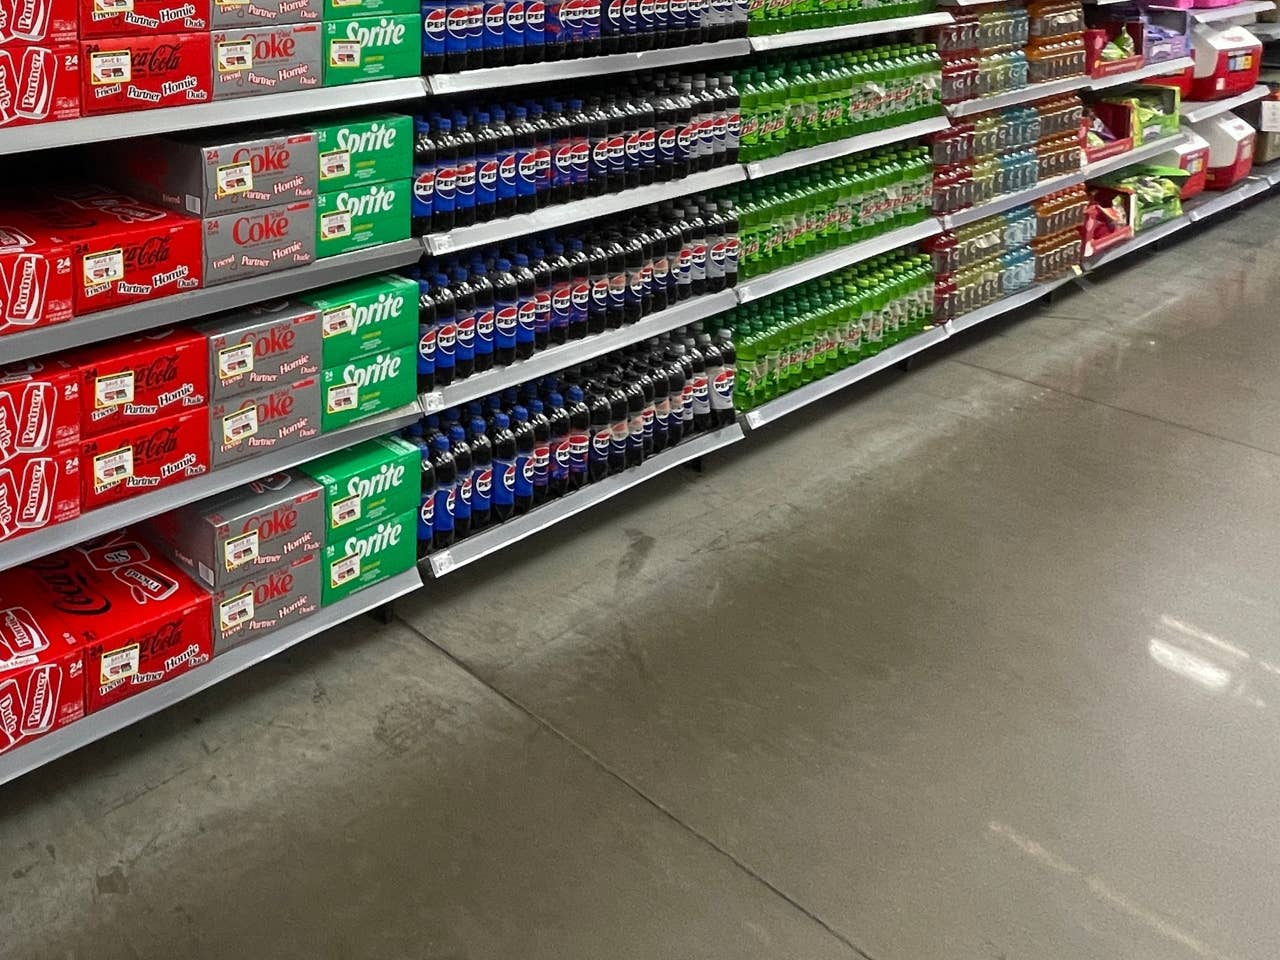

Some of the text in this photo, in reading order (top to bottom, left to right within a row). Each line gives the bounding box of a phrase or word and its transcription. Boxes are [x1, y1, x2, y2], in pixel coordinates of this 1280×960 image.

[336, 123, 395, 155] Sprite
[233, 211, 286, 245] Coke
[14, 258, 34, 317] Partner
[343, 354, 400, 388] Sprite
